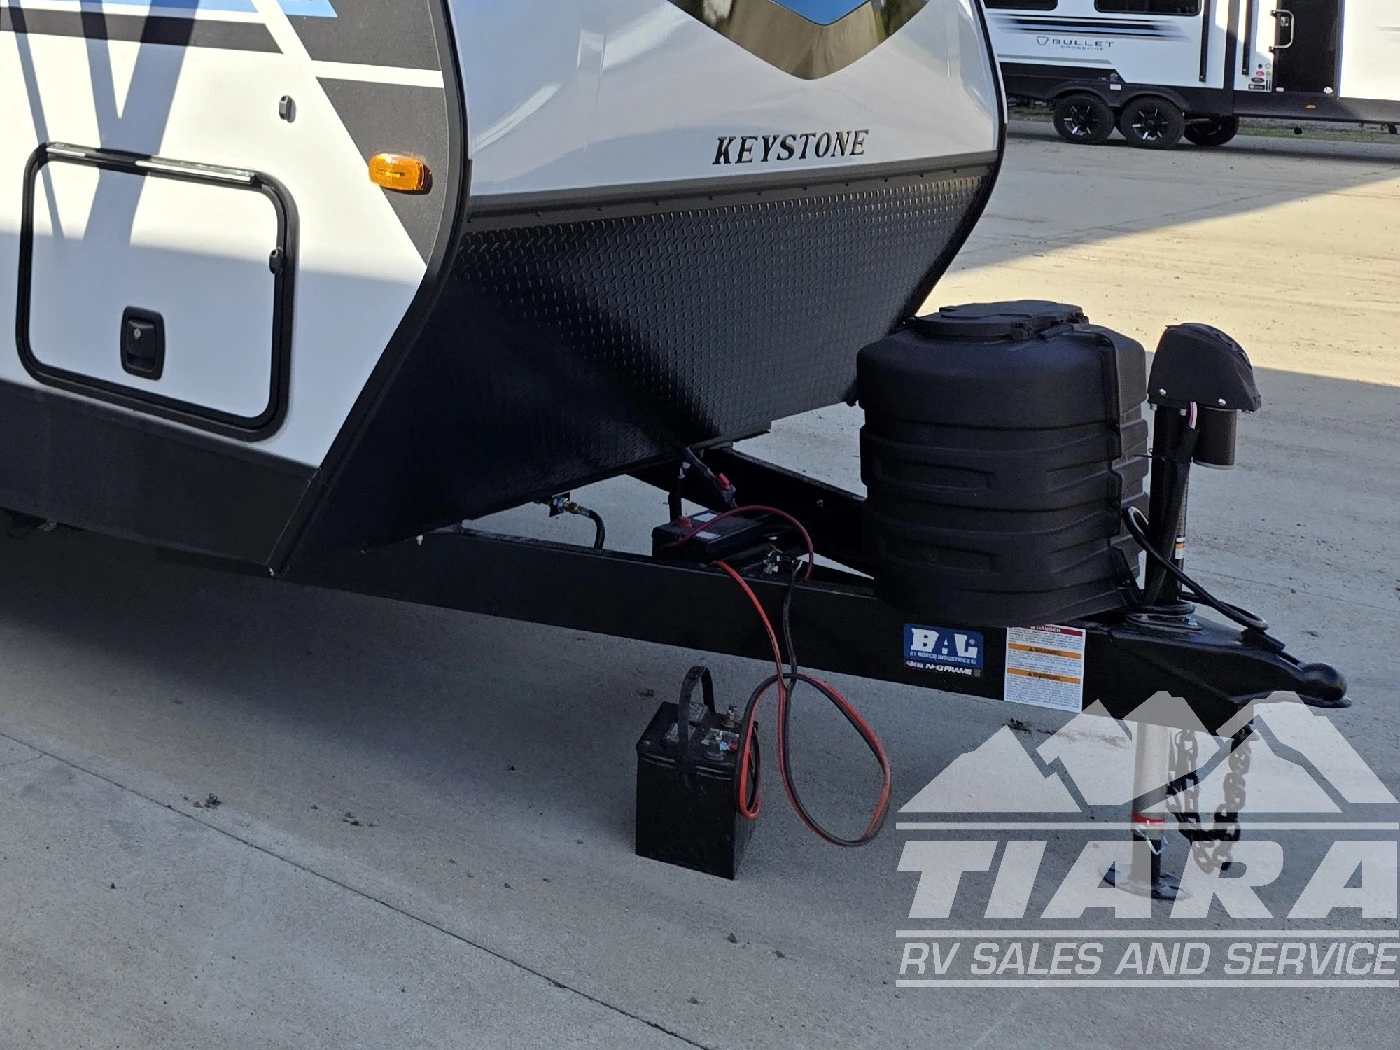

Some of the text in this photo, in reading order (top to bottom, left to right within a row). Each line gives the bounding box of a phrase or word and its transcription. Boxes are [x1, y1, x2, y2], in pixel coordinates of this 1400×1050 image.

[1052, 38, 1115, 48] BULLET
[712, 129, 869, 165] KEYSTONE
[910, 628, 978, 659] BAL
